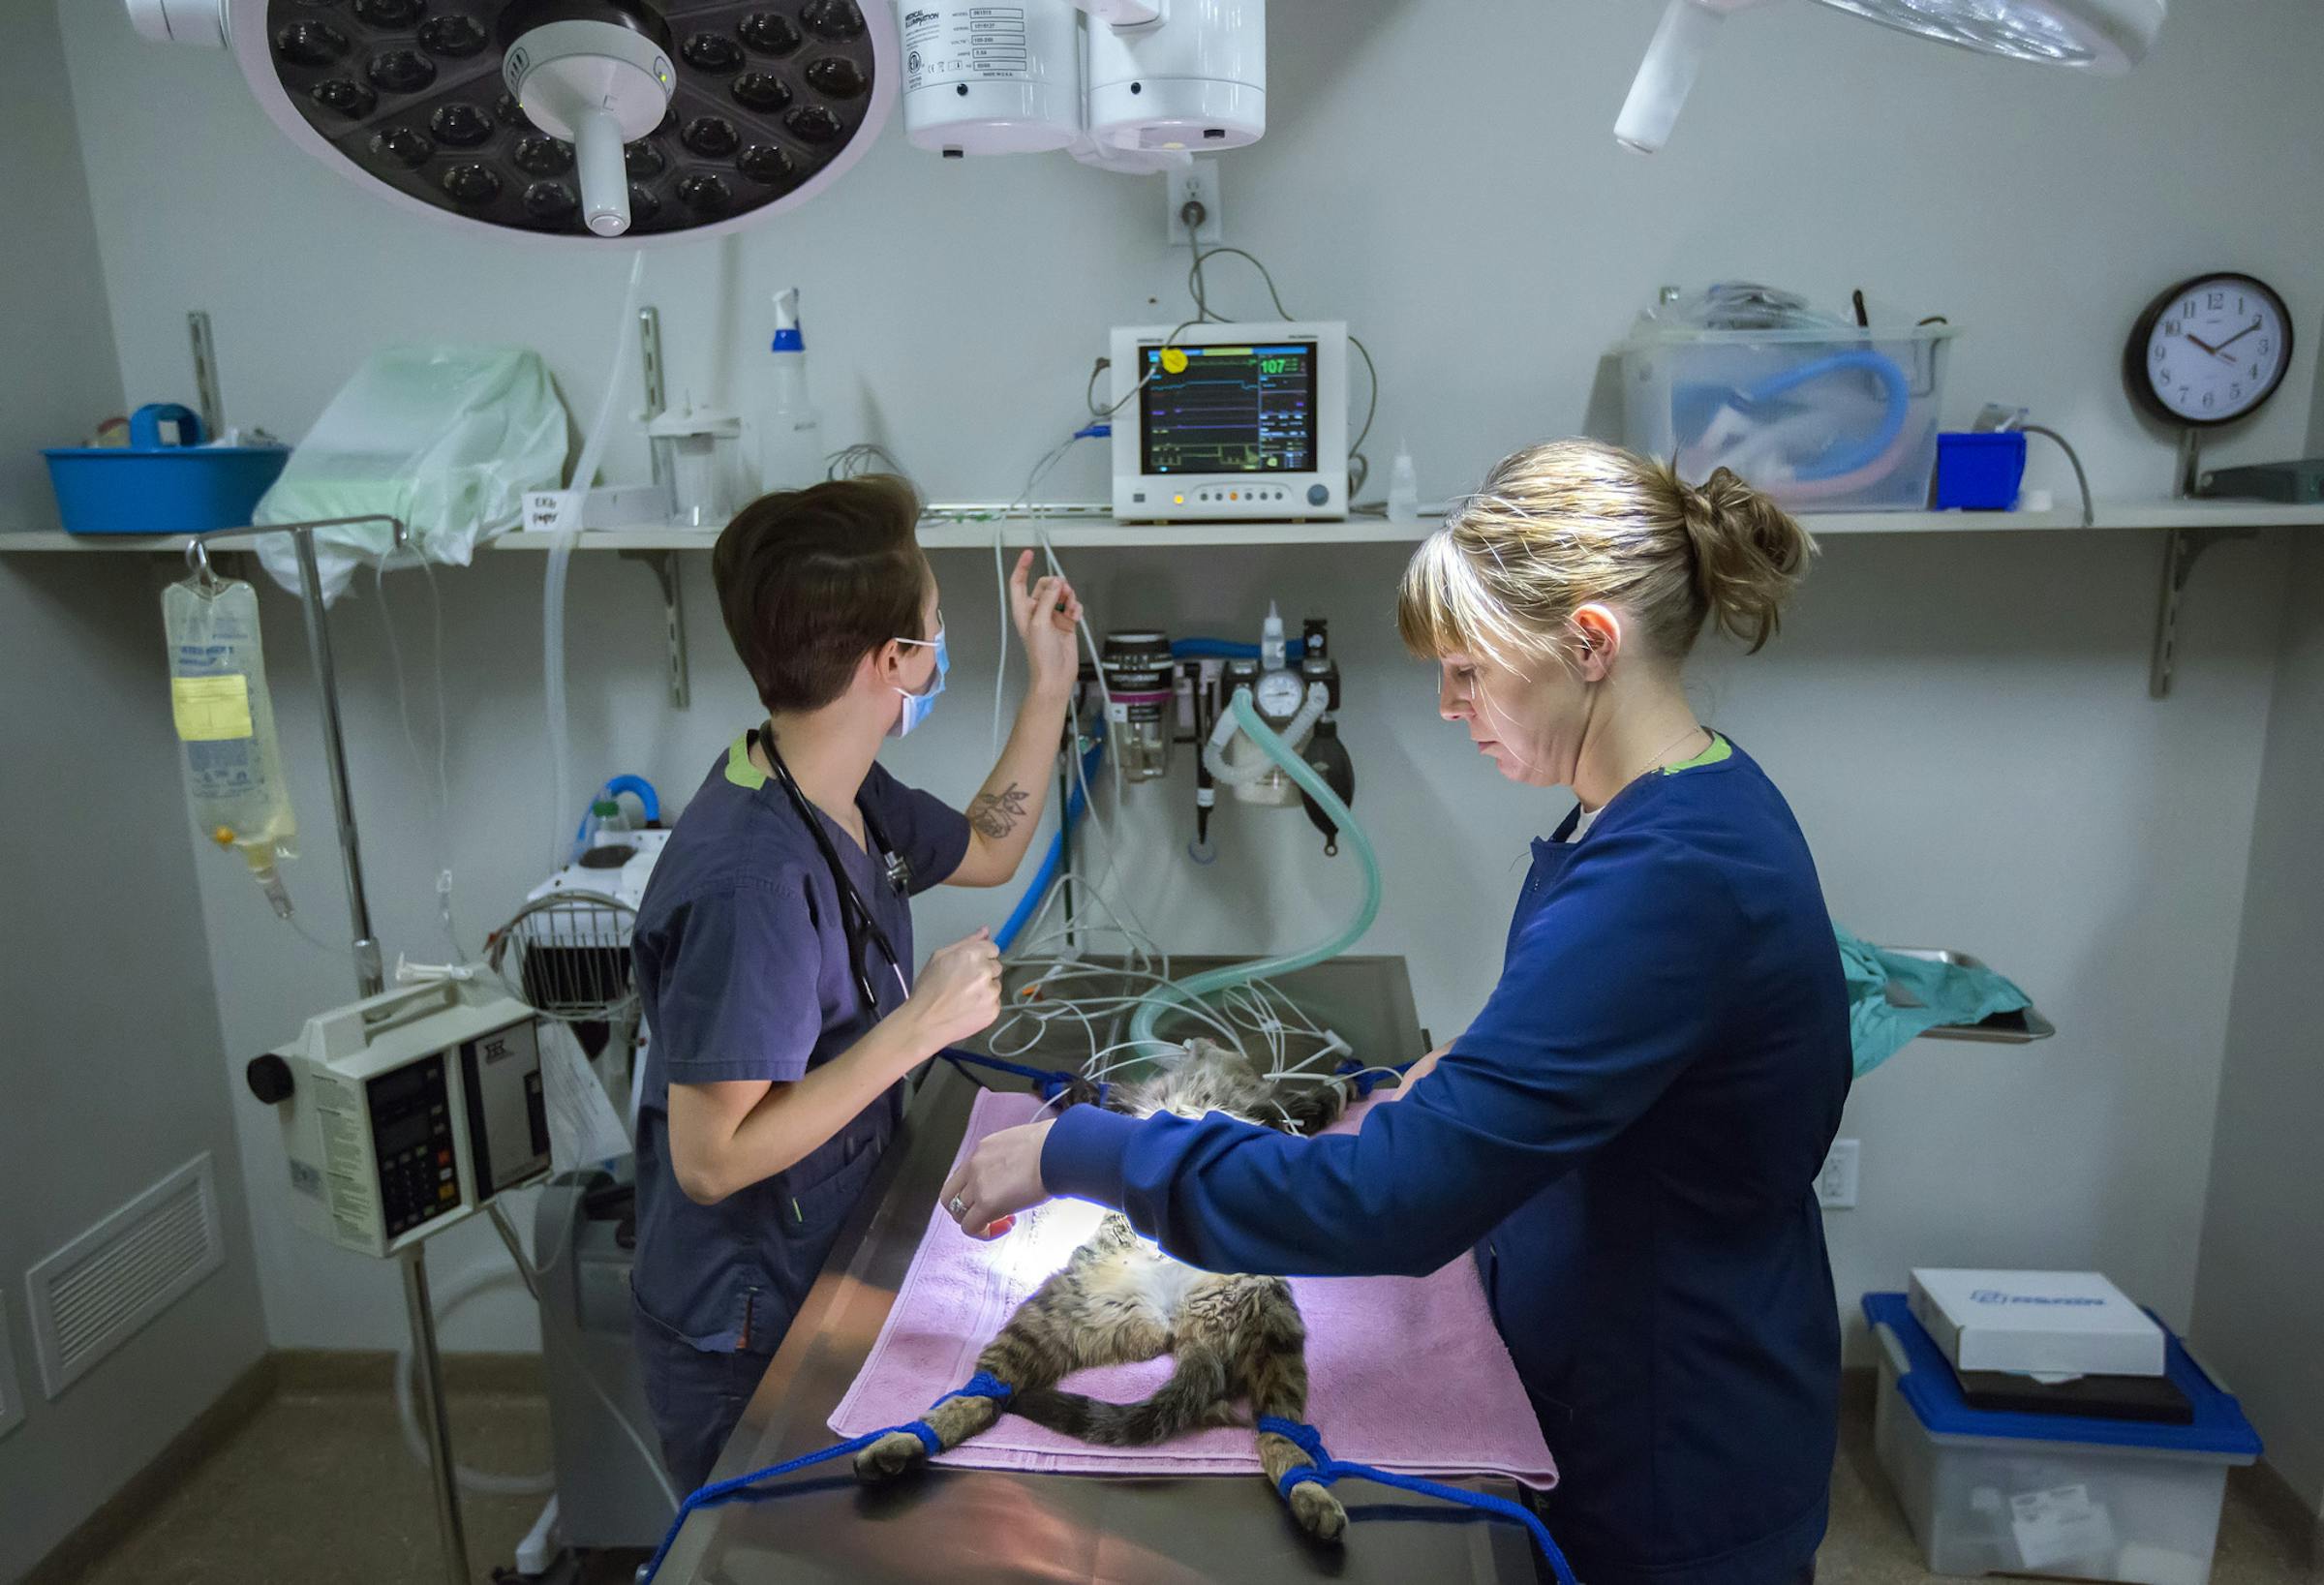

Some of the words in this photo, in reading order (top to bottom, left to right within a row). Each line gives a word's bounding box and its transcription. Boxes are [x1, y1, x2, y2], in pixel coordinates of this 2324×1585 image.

[2184, 300, 2196, 319] 11
[2207, 293, 2225, 310] 12
[2238, 296, 2245, 315] 1
[2164, 320, 2181, 337] 10
[2251, 314, 2263, 330] 2
[2155, 347, 2166, 362] 9
[2258, 339, 2269, 355] 3
[1262, 358, 1286, 374] 107
[2249, 363, 2258, 380] 4
[2159, 368, 2171, 385] 8
[2179, 386, 2189, 403] 7
[2230, 382, 2241, 399] 5
[2202, 391, 2214, 408] 6
